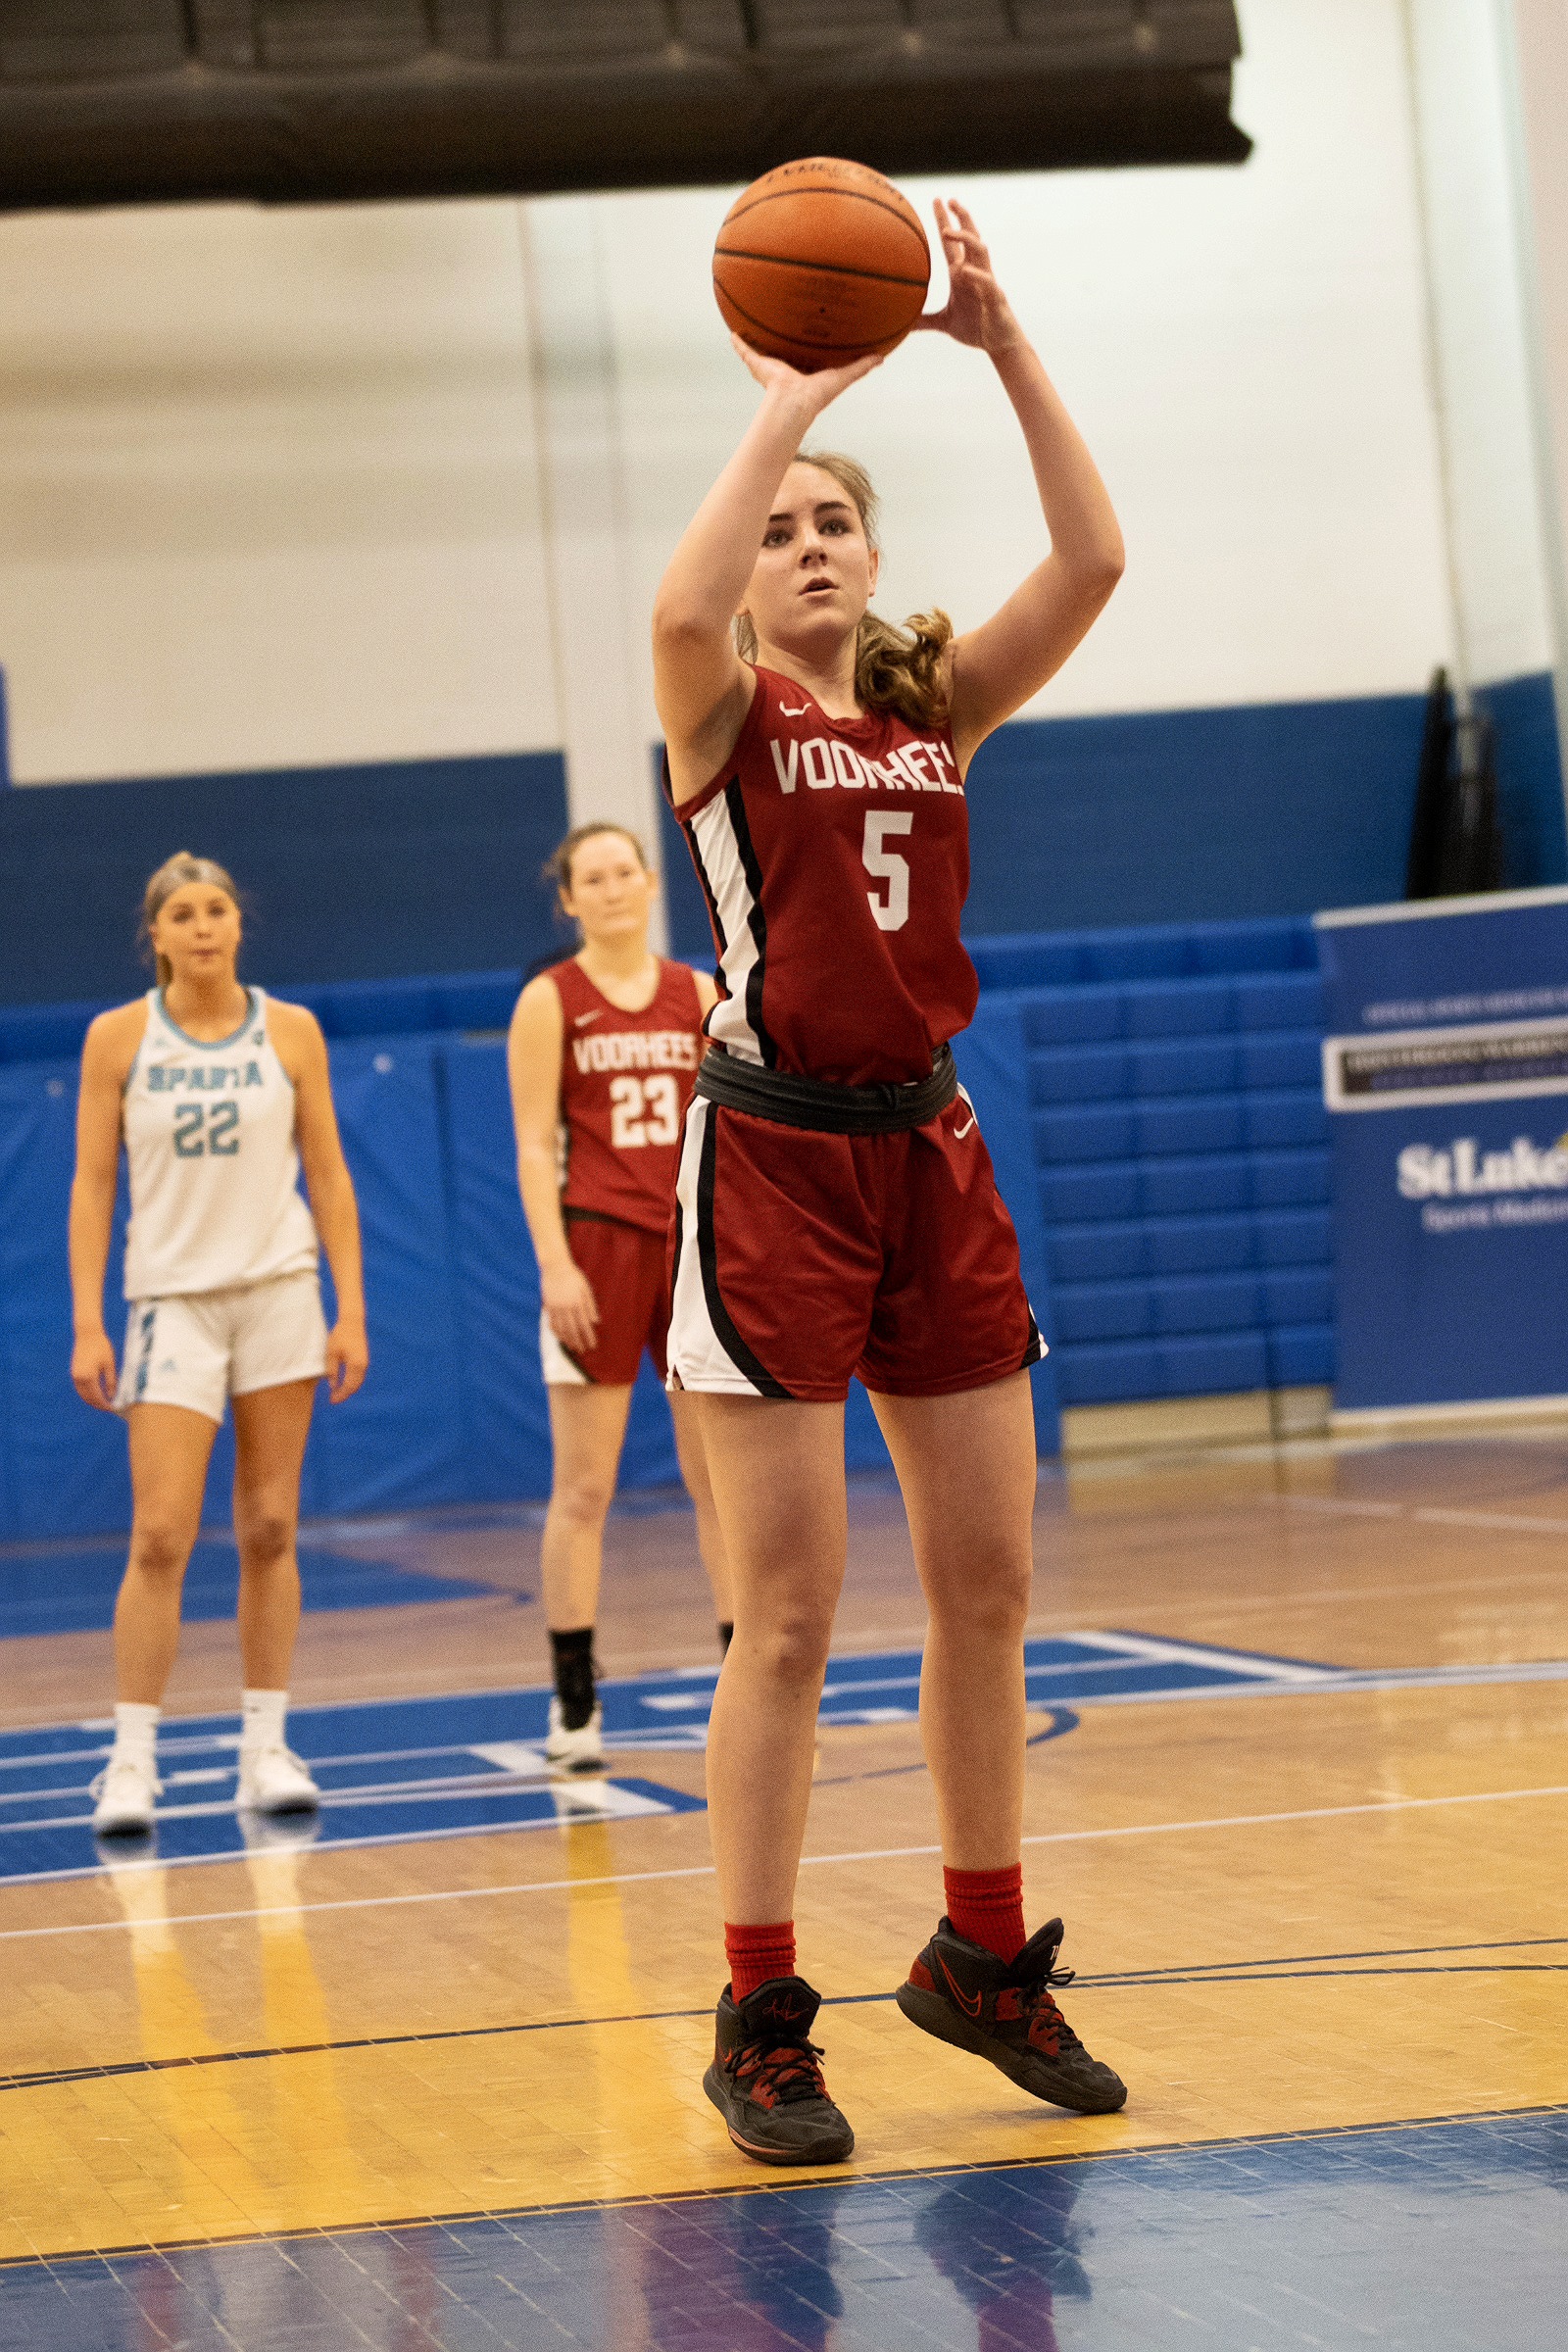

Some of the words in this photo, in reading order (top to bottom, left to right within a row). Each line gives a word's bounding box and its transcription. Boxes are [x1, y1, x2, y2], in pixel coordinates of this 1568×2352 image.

[769, 737, 965, 797] VOOHEE
[861, 809, 914, 932] 5
[571, 1030, 699, 1075] VOORHEES
[172, 1101, 240, 1158] 22
[610, 1073, 680, 1150] 23
